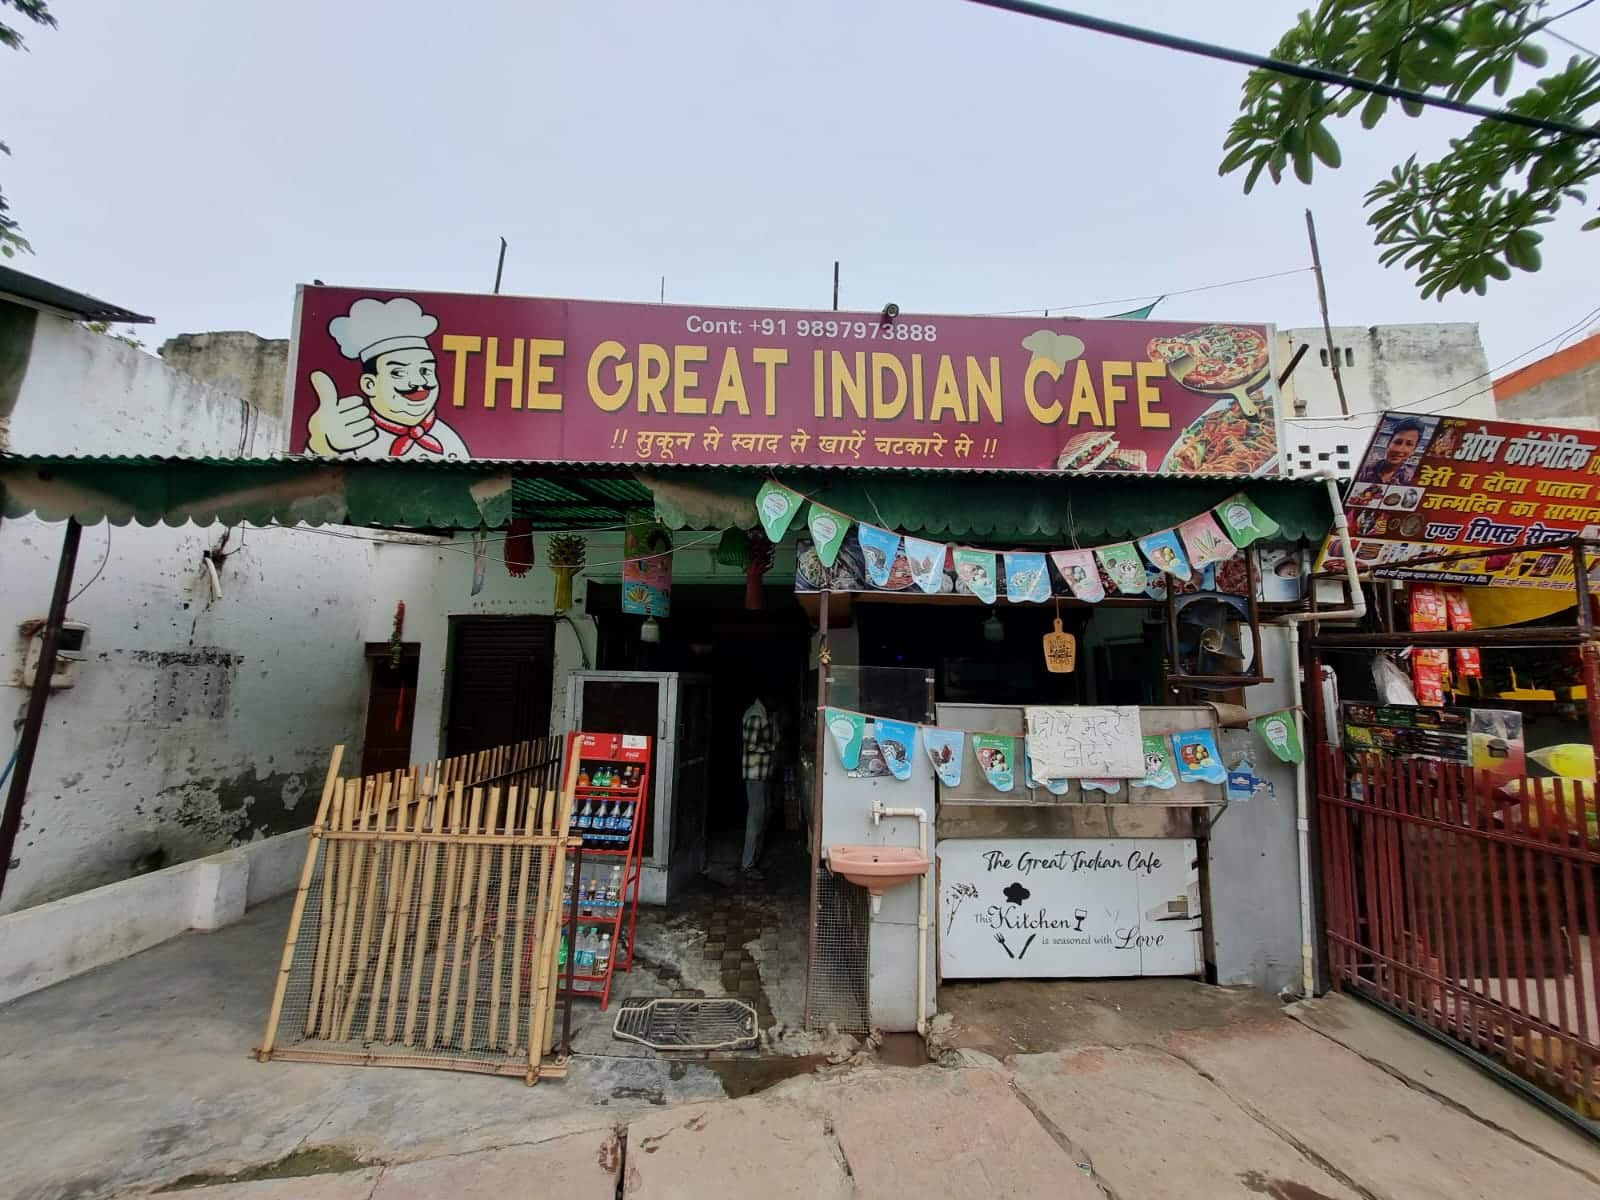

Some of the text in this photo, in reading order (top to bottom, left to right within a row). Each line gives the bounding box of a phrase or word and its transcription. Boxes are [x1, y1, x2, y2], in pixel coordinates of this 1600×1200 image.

[686, 315, 937, 342] Cont: +91 9897973888
[442, 334, 1171, 429] THE GREAT INDIAN CAFE
[636, 430, 696, 459] सुकून
[703, 426, 723, 451] से
[731, 431, 782, 454] स्वाद
[790, 427, 810, 454] से
[874, 435, 948, 458] चटकारे
[953, 433, 974, 458] से
[1454, 426, 1506, 464] ओम
[1417, 464, 1455, 488] डेरी
[1459, 473, 1479, 490] व
[1422, 493, 1507, 515] जन्मदिन
[1509, 501, 1540, 518] का
[982, 850, 1162, 876] The Great Indian Cafe
[987, 904, 1072, 930] Kitchen
[1052, 934, 1092, 945] seasoned
[1094, 934, 1113, 945] with
[1114, 927, 1165, 950] Love
